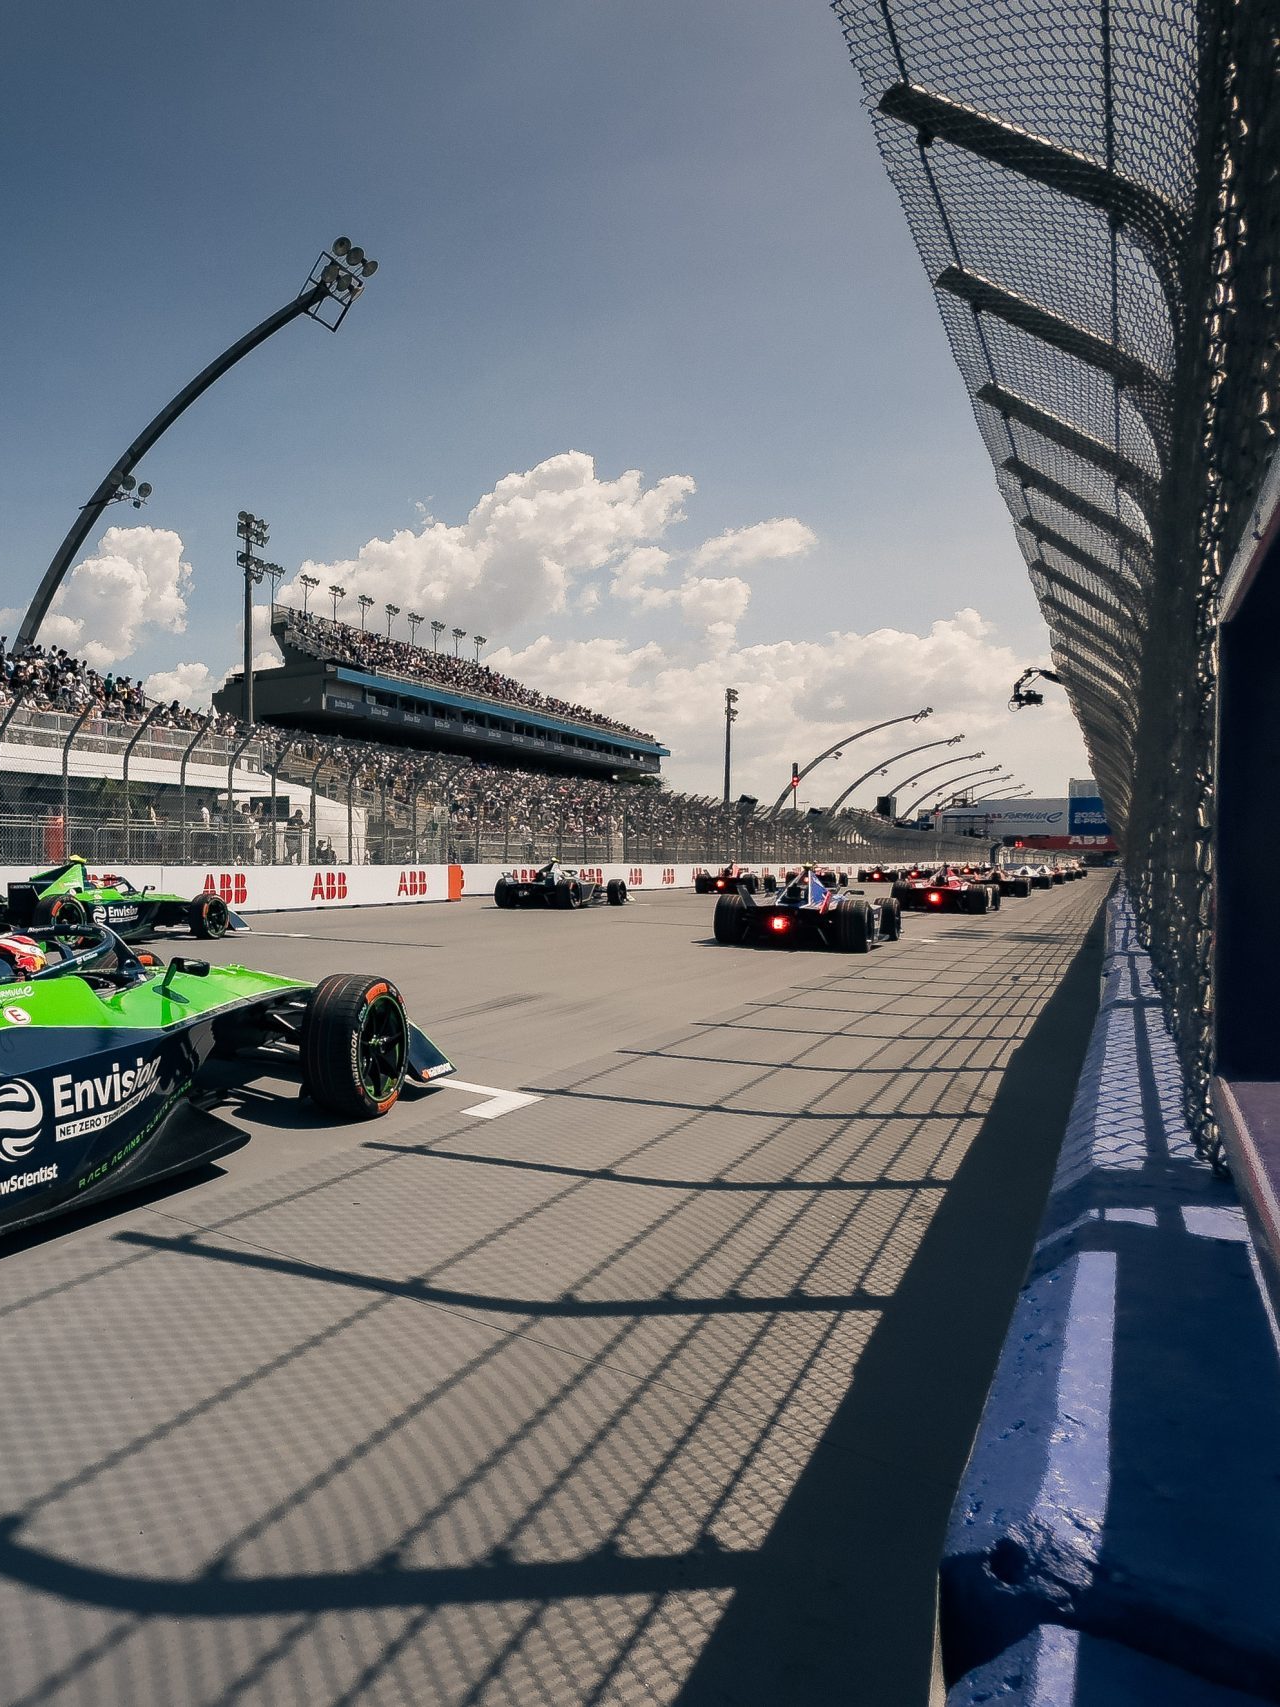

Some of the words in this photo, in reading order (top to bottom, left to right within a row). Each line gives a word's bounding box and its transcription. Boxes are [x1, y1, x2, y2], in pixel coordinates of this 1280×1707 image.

[1068, 835, 1109, 845] ABB
[203, 872, 248, 905] ABB
[310, 871, 348, 901] ABB
[397, 870, 428, 897] ABB
[628, 867, 643, 886] ABB
[662, 868, 675, 885] ABB
[52, 1056, 162, 1118] Envision
[59, 1123, 77, 1138] NET
[78, 1117, 102, 1132] ZERO
[78, 1162, 108, 1189] RACE
[111, 1130, 145, 1166] AGAINST
